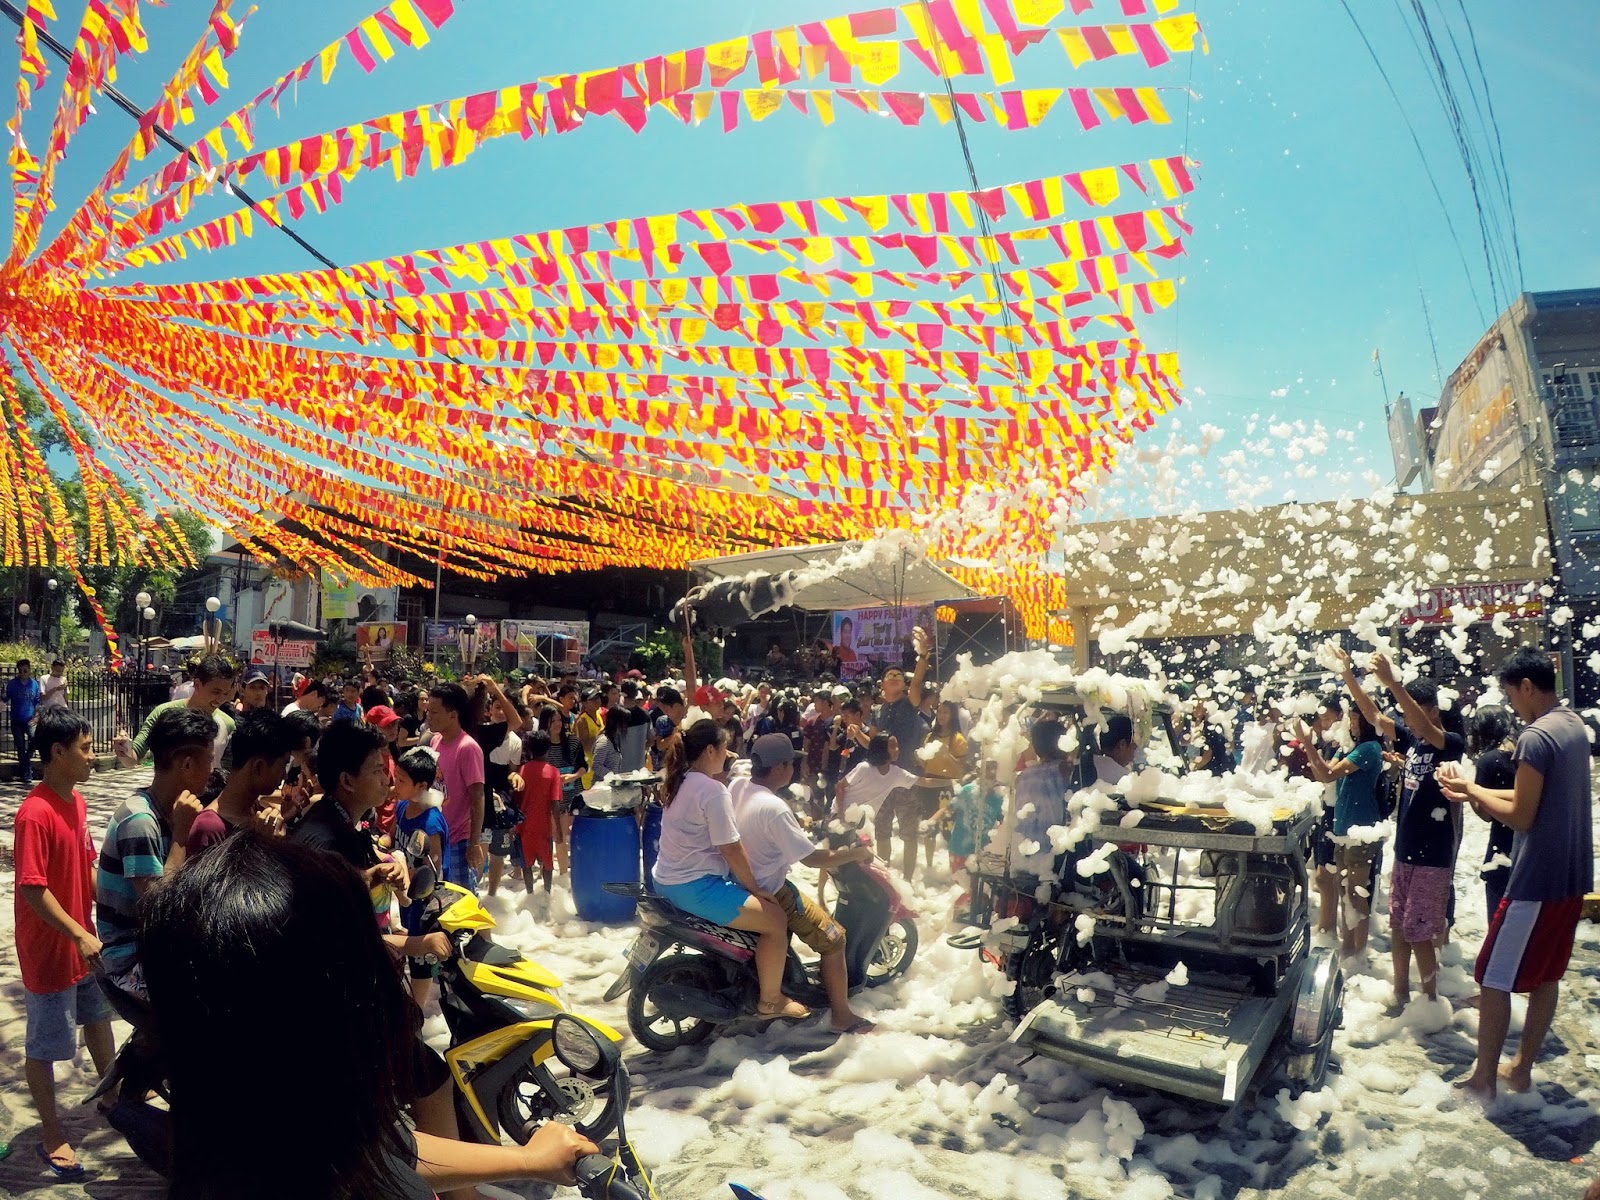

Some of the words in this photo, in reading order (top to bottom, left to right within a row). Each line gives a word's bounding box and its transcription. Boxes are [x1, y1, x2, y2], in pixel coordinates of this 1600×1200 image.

[857, 609, 883, 621] HAPPY
[884, 608, 908, 619] FITA
[264, 643, 276, 656] 20
